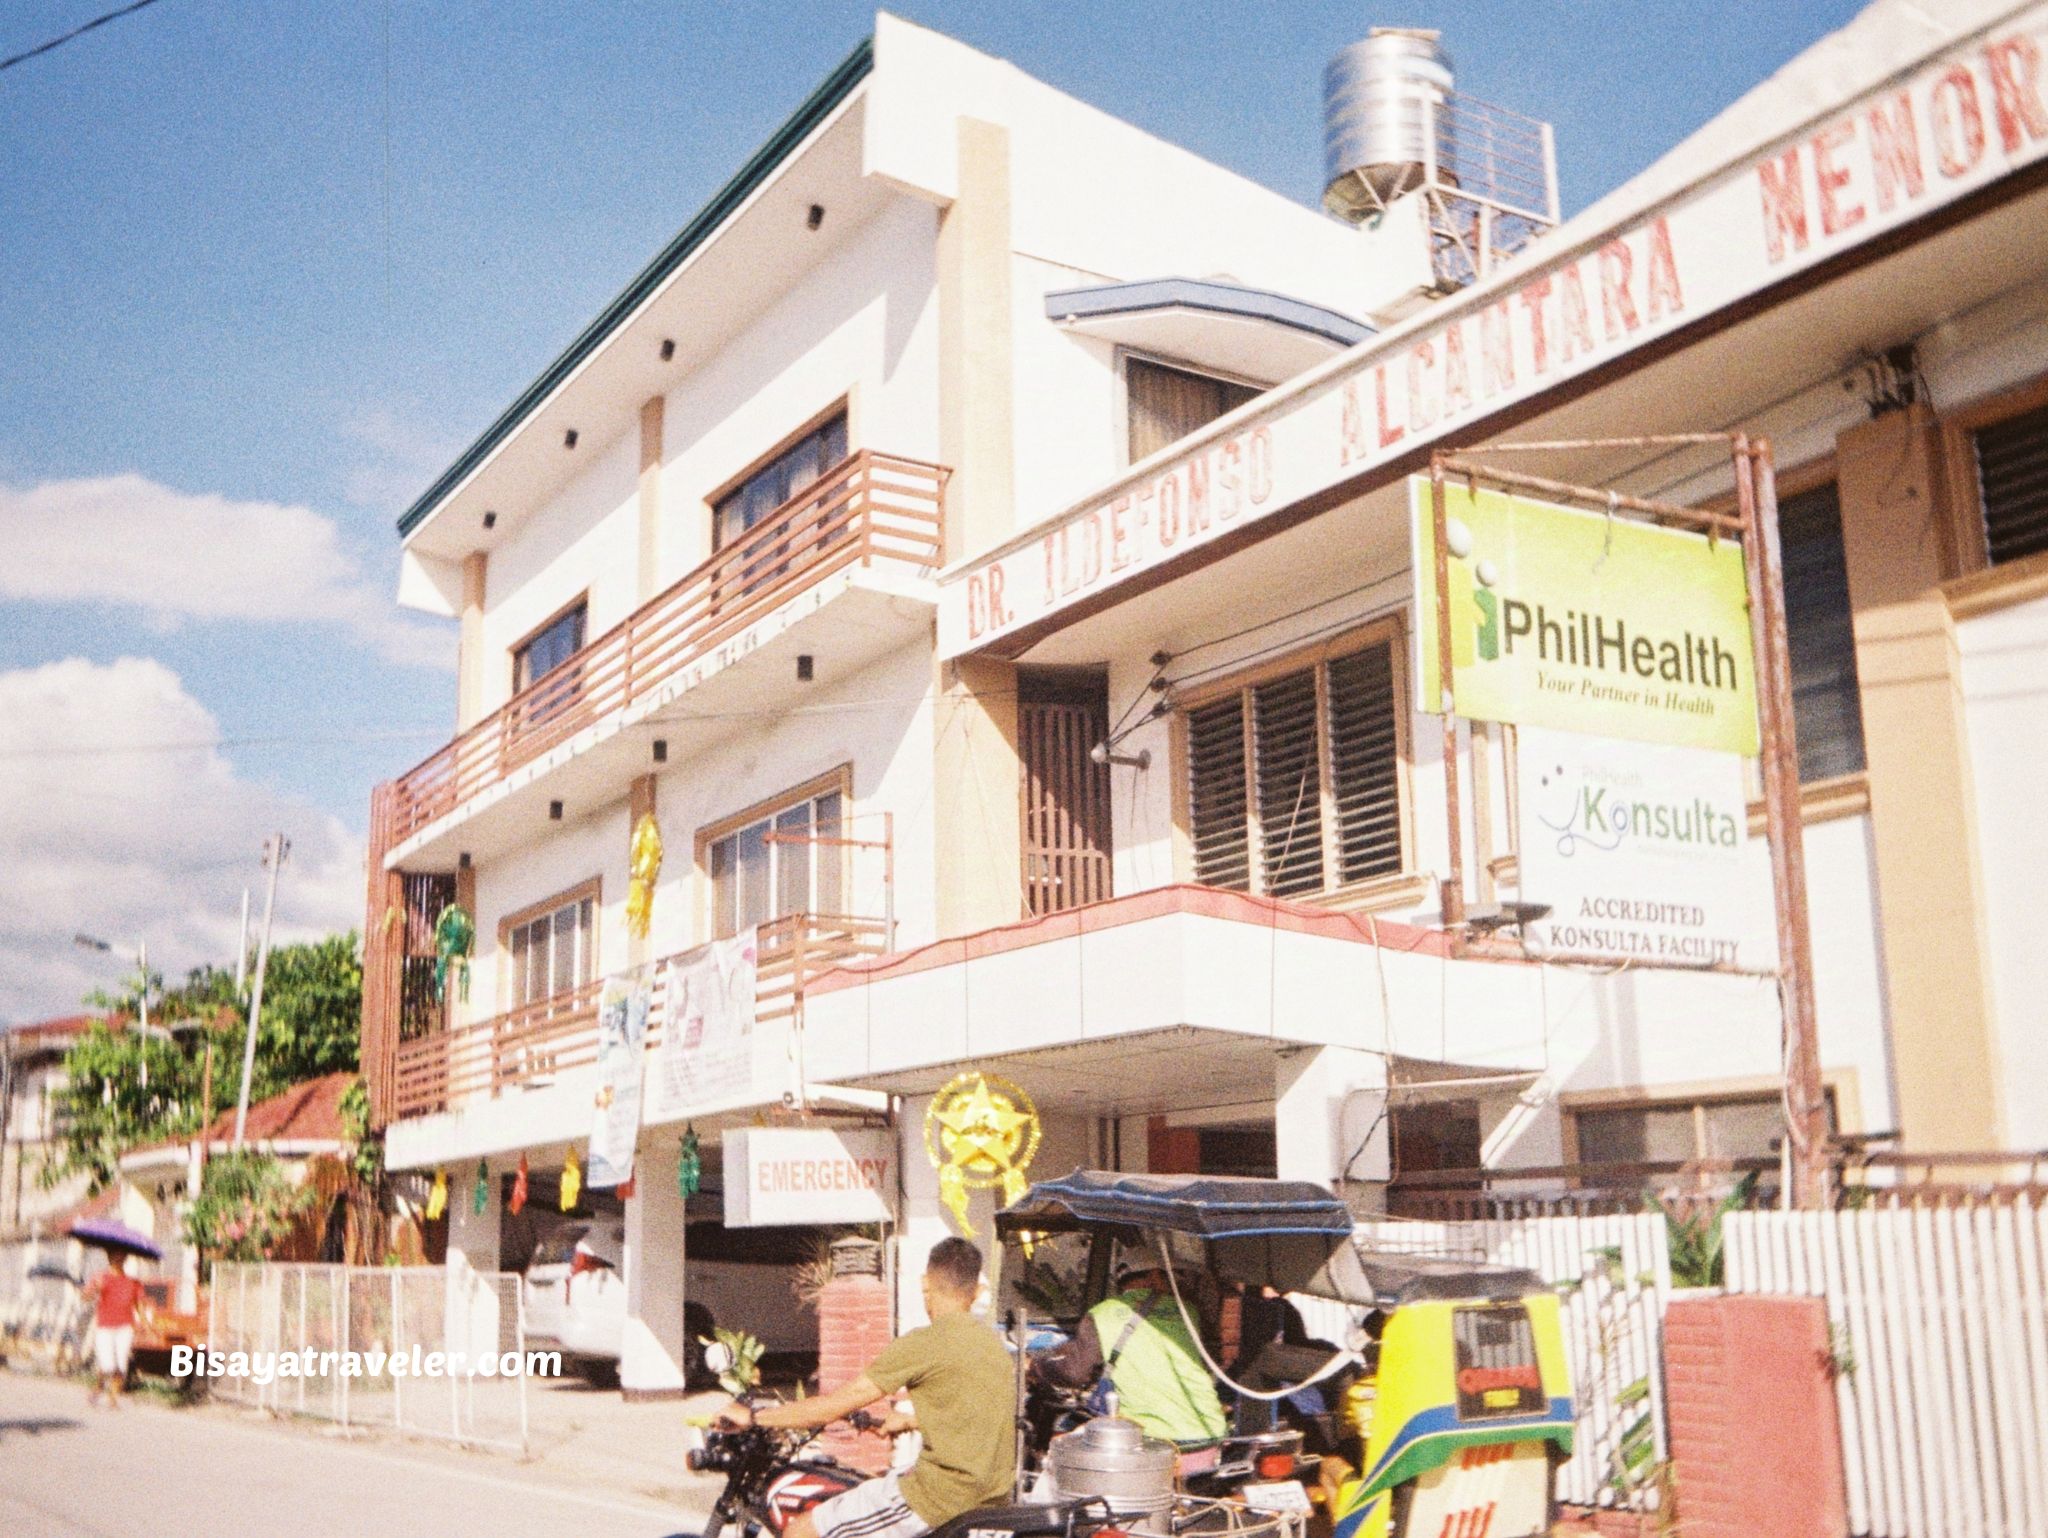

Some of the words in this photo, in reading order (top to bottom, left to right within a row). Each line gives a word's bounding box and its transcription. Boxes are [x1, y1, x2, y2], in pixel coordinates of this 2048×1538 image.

[968, 562, 1014, 640] DR.
[1340, 216, 1684, 467] ALCANTARA
[1503, 598, 1737, 690] PhilHealth
[1537, 670, 1576, 694] Your
[1581, 678, 1640, 704] Partner
[1645, 687, 1660, 707] in
[1665, 691, 1716, 716] Health
[1584, 786, 1738, 848] Konsulta
[1579, 897, 1705, 927] ACCREDITED
[1550, 925, 1656, 954] KONSULTA
[758, 1159, 888, 1192] EMERGENCY
